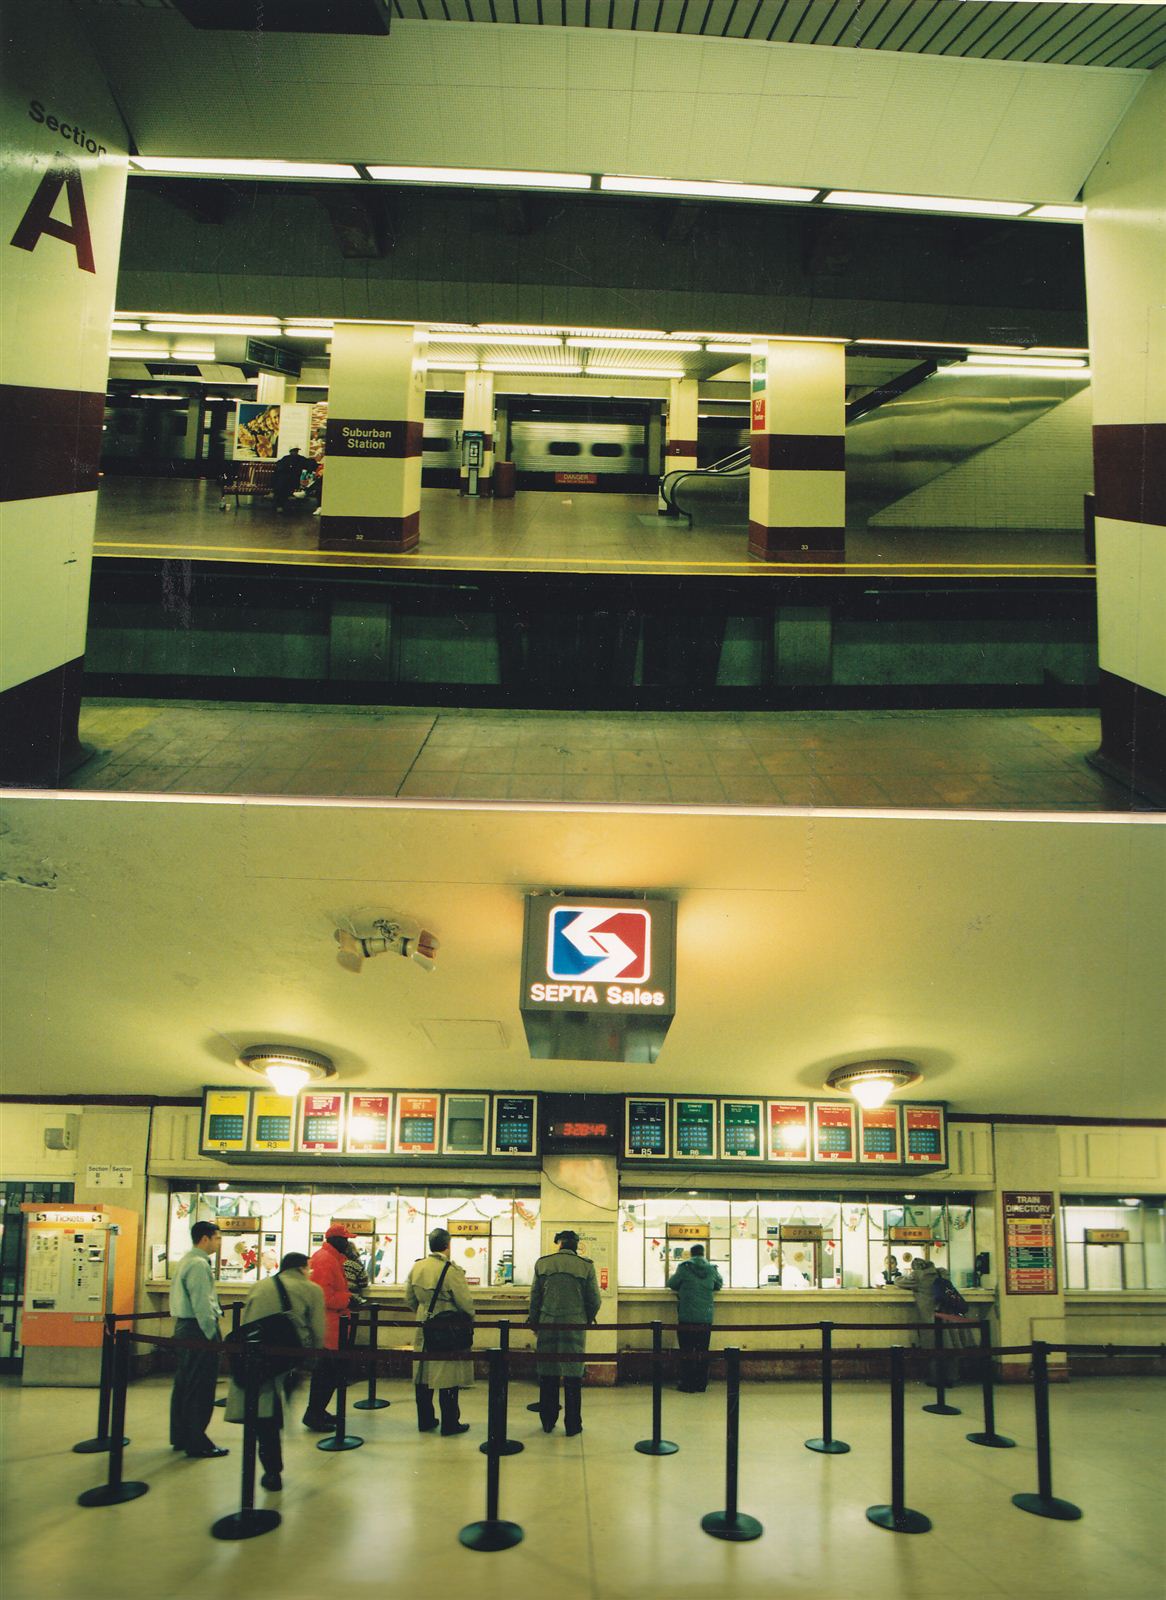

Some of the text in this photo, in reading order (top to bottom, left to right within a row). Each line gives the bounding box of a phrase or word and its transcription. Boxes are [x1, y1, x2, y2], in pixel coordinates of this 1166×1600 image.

[28, 100, 107, 156] Section
[10, 155, 96, 274] A
[342, 427, 392, 438] Suburban
[347, 438, 386, 449] Station
[563, 473, 589, 481] DANGER
[531, 983, 666, 1007] SEPTA Sales
[1016, 1196, 1041, 1204] TRAIN
